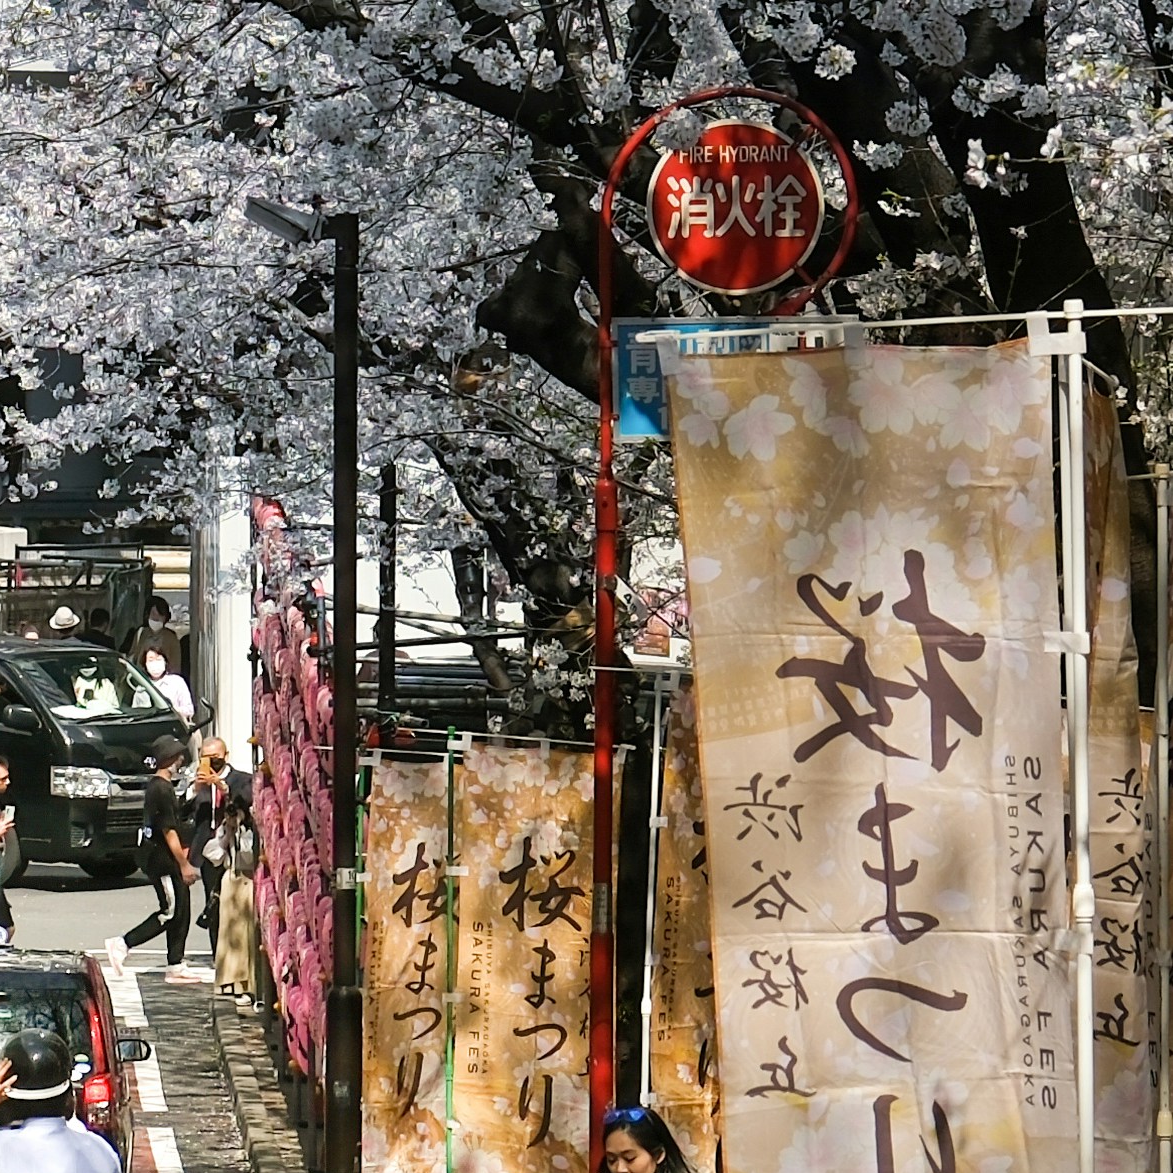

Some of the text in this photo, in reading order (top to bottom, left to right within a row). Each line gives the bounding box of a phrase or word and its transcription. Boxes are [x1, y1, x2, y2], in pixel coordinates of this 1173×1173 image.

[667, 174, 807, 239] 消火栓
[679, 145, 791, 164] FIRE HYDRANT
[392, 842, 459, 1118] 桜まつり
[467, 920, 483, 1075] SAKURA FES
[499, 836, 585, 1149] 桜まつり
[657, 876, 675, 1042] SAKURA FES
